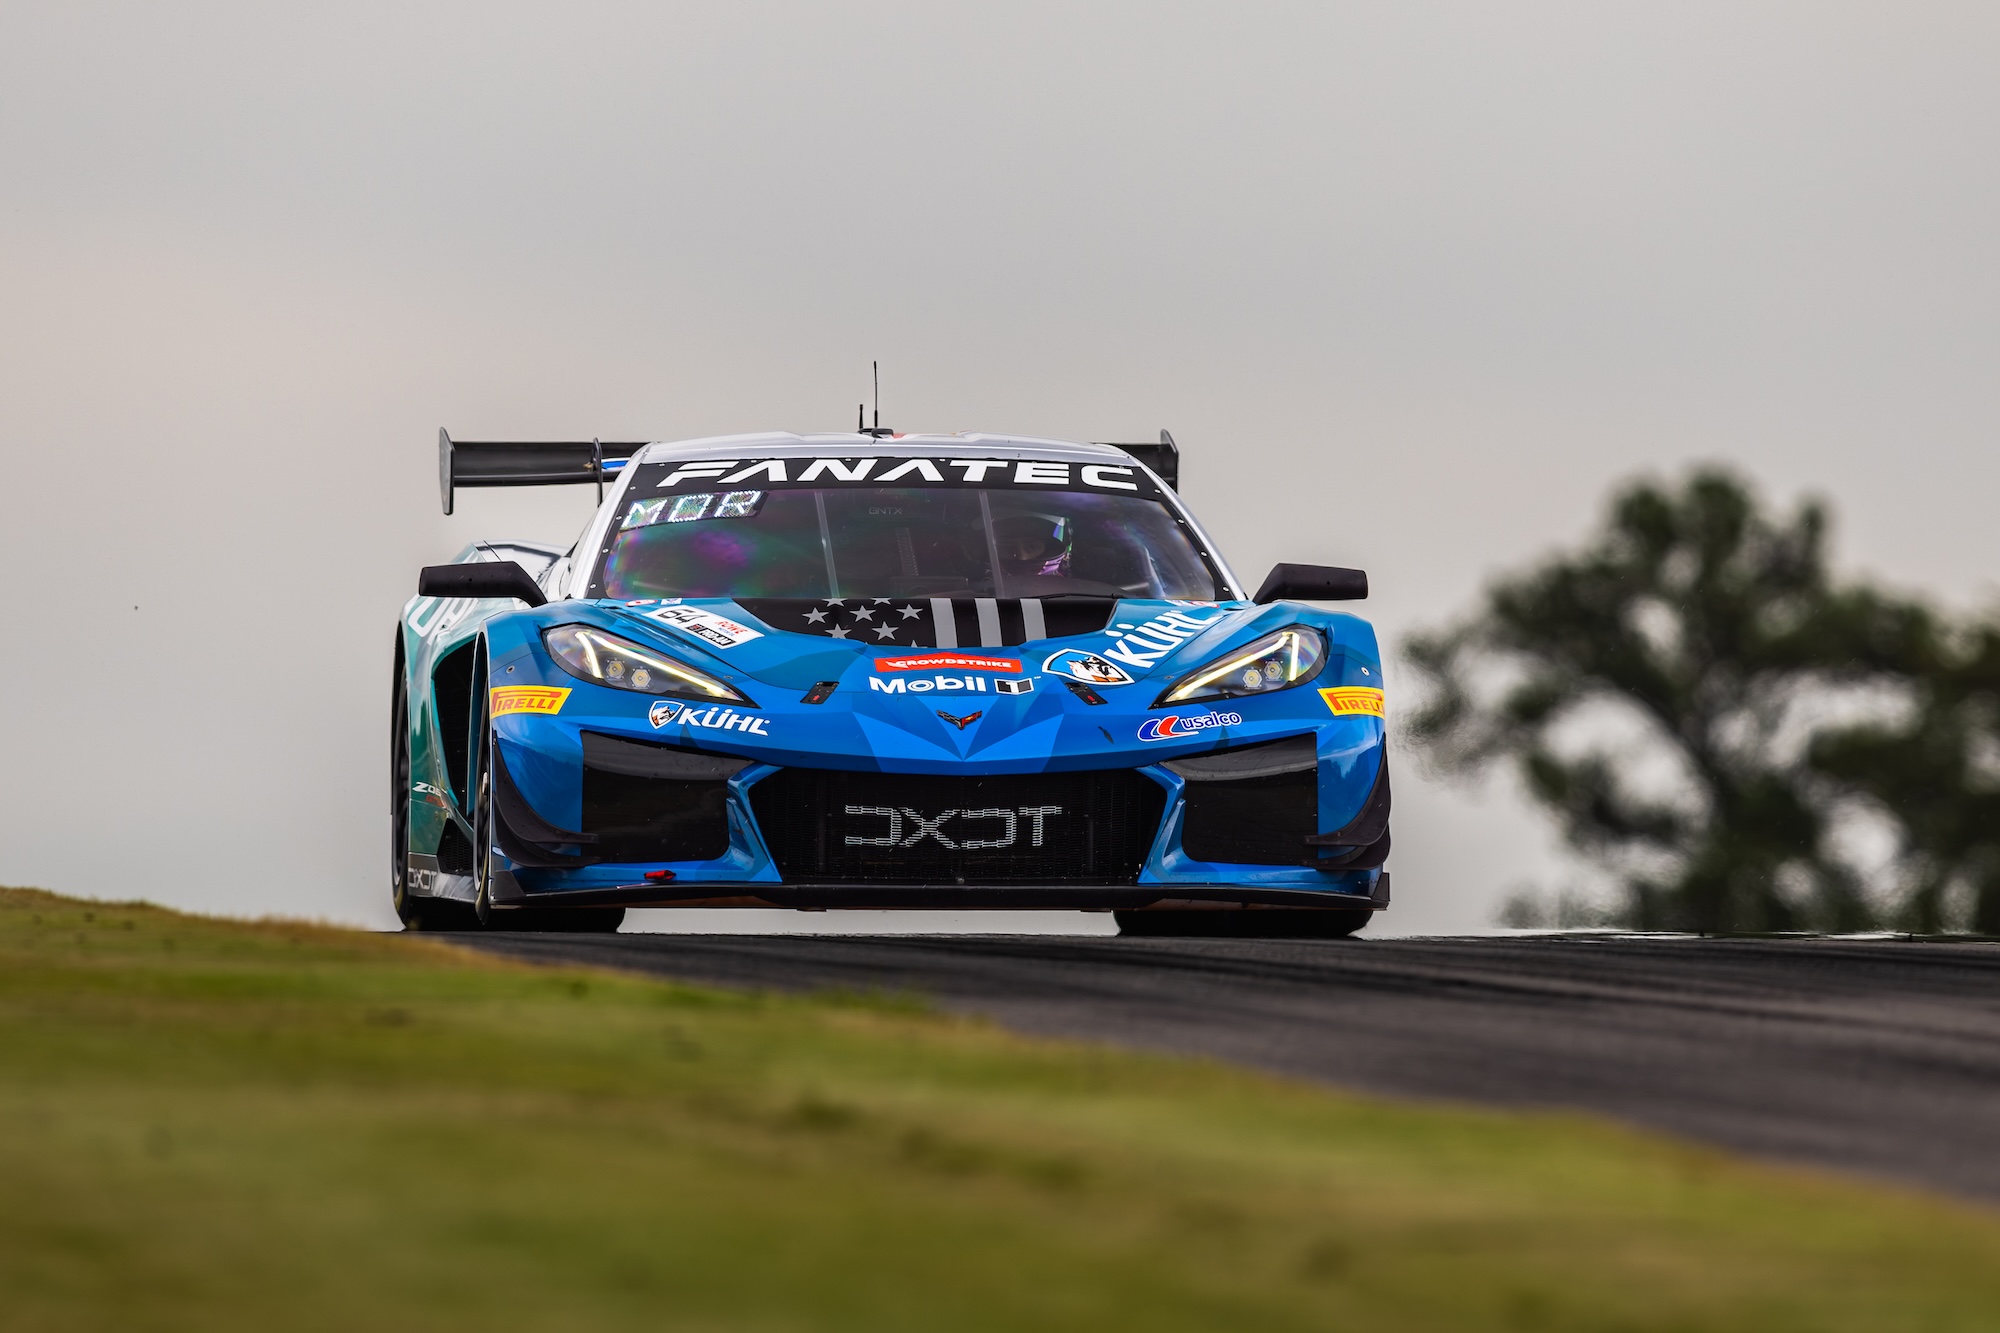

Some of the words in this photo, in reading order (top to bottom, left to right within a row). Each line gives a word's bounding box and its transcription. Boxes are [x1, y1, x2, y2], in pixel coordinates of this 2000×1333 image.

[656, 459, 1138, 490] FANATEC
[621, 490, 761, 528] MOR
[869, 506, 902, 515] GNTX
[657, 608, 708, 624] 64
[1103, 611, 1224, 668] KÜHL
[892, 658, 1012, 668] CROWDSTRIKE
[869, 675, 986, 694] Mobil
[491, 690, 562, 714] PIRELLI
[677, 706, 769, 736] KÜHL
[1180, 711, 1241, 729] usalco
